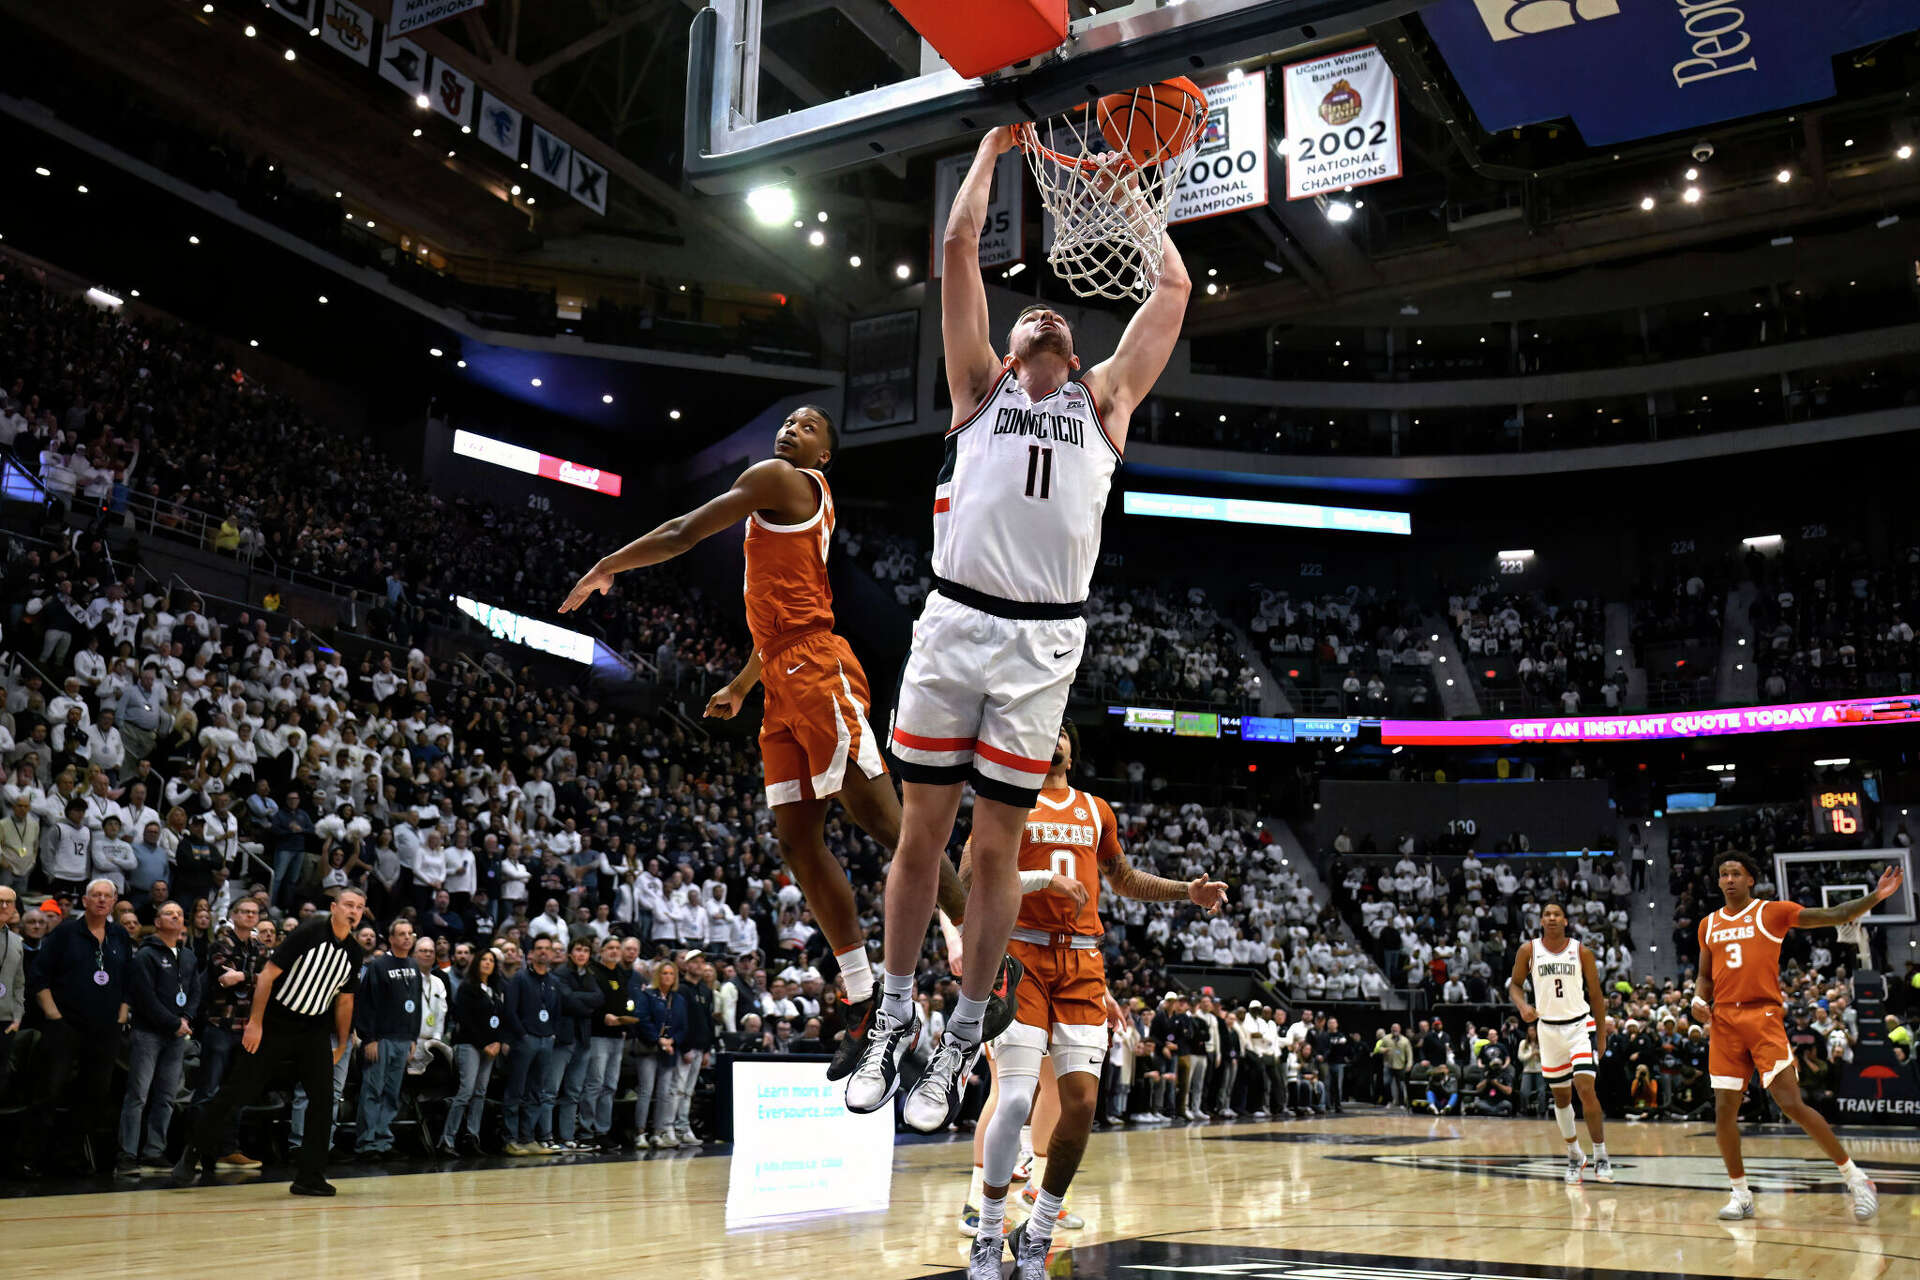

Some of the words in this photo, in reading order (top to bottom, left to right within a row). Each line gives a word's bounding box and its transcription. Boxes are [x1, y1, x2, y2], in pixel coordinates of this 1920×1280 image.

[1296, 60, 1331, 75] UConn
[1333, 48, 1381, 66] Women'
[1312, 62, 1368, 83] Basketball
[1298, 120, 1388, 162] 2002
[1307, 151, 1380, 175] NATIONAL
[1180, 179, 1248, 202] NATIONAL
[1301, 164, 1387, 192] CHAMPIONS
[1174, 193, 1255, 219] CHAMPIONS
[1025, 445, 1052, 499] 11
[1500, 560, 1524, 575] 223
[1510, 723, 1547, 738] GET
[1550, 722, 1577, 738] AN
[1584, 719, 1668, 737] INSTANT
[1671, 714, 1741, 734] QUOTE
[1744, 707, 1817, 727] TODAY
[1820, 791, 1858, 808] 18:44
[1025, 821, 1095, 847] TEXAS
[1832, 809, 1857, 834] 16
[74, 841, 84, 856] 12
[1050, 849, 1076, 881] 0
[1711, 925, 1755, 943] TEXAS
[1725, 943, 1742, 968] 3
[1554, 978, 1563, 998] 2
[1836, 1097, 1920, 1115] TRAVELERS
